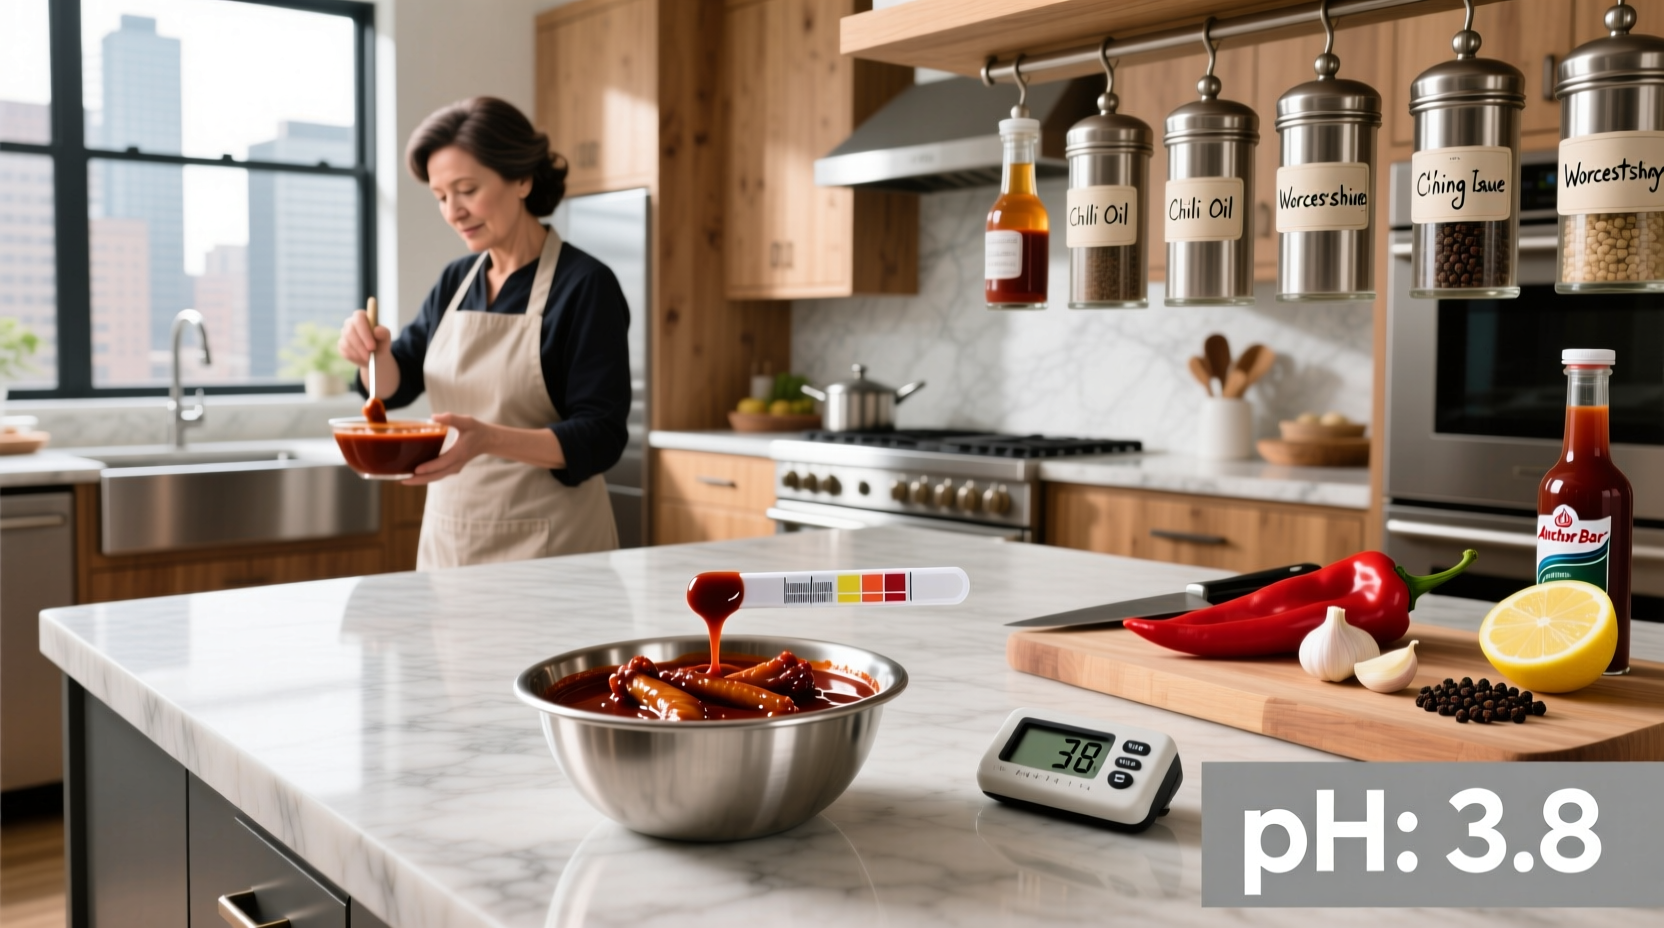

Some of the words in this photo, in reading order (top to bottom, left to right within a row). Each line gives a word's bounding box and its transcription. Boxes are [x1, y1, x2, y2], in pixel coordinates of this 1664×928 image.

[1104, 202, 1128, 226] Oil
[1169, 196, 1201, 221] Chili
[1209, 195, 1233, 219] Oil
